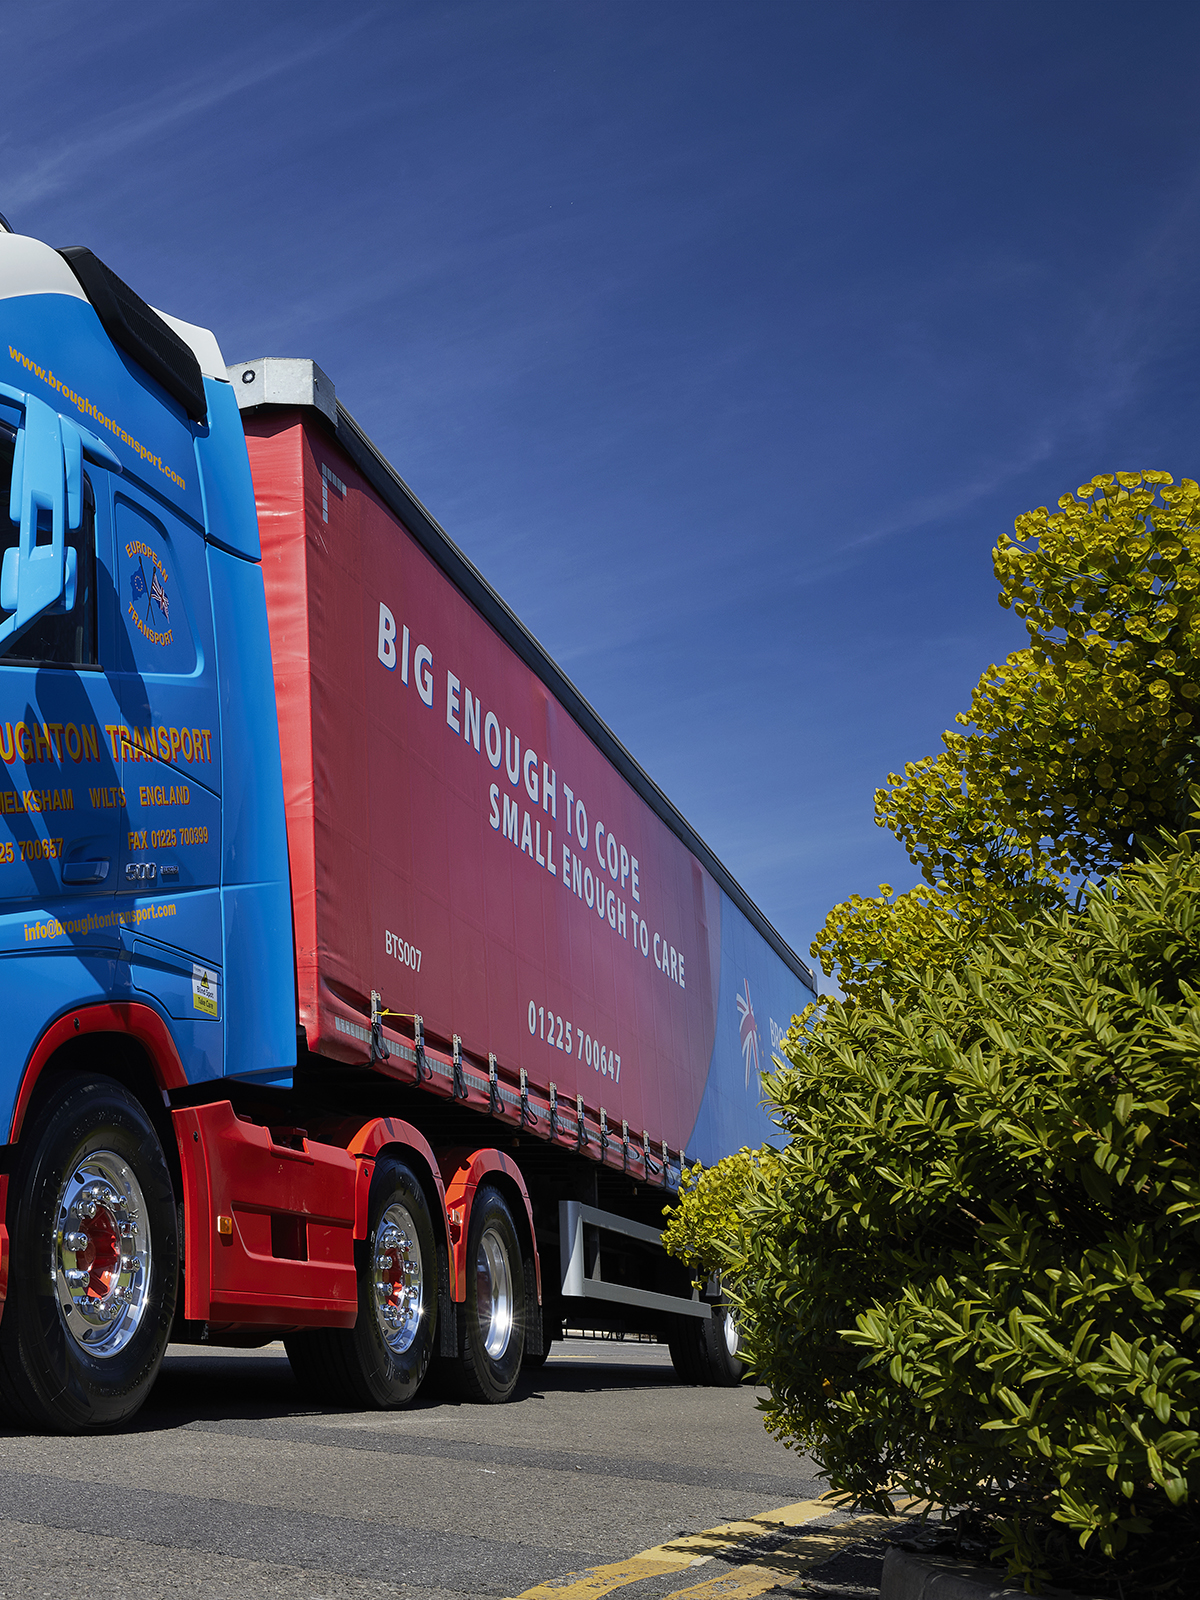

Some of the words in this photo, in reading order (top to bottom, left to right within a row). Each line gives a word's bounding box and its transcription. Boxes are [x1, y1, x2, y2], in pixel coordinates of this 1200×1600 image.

[8, 345, 186, 490] www.broughtontransport.com
[125, 541, 169, 583] EUROPEAN
[128, 601, 174, 647] TRANSPORT
[104, 724, 212, 764] TRANSPORT
[377, 601, 434, 707] BIG
[446, 669, 557, 819] ENOUGH
[563, 782, 589, 850] TO
[594, 820, 641, 903] COPE
[88, 786, 127, 809] WILTS
[139, 785, 191, 807] ENGLAND
[18, 837, 64, 862] 700657
[128, 830, 149, 851] FAX
[151, 828, 178, 850] 01225
[179, 826, 209, 846] 700399
[125, 862, 157, 881] 500
[488, 782, 558, 876] SMALL
[562, 843, 628, 940] ENOUGH
[630, 909, 650, 958] TO
[653, 931, 687, 989] CARE
[23, 903, 177, 942] info@broughtontransport.com
[385, 929, 423, 973] BTS007
[527, 999, 573, 1055] 01225
[576, 1028, 621, 1084] 700647
